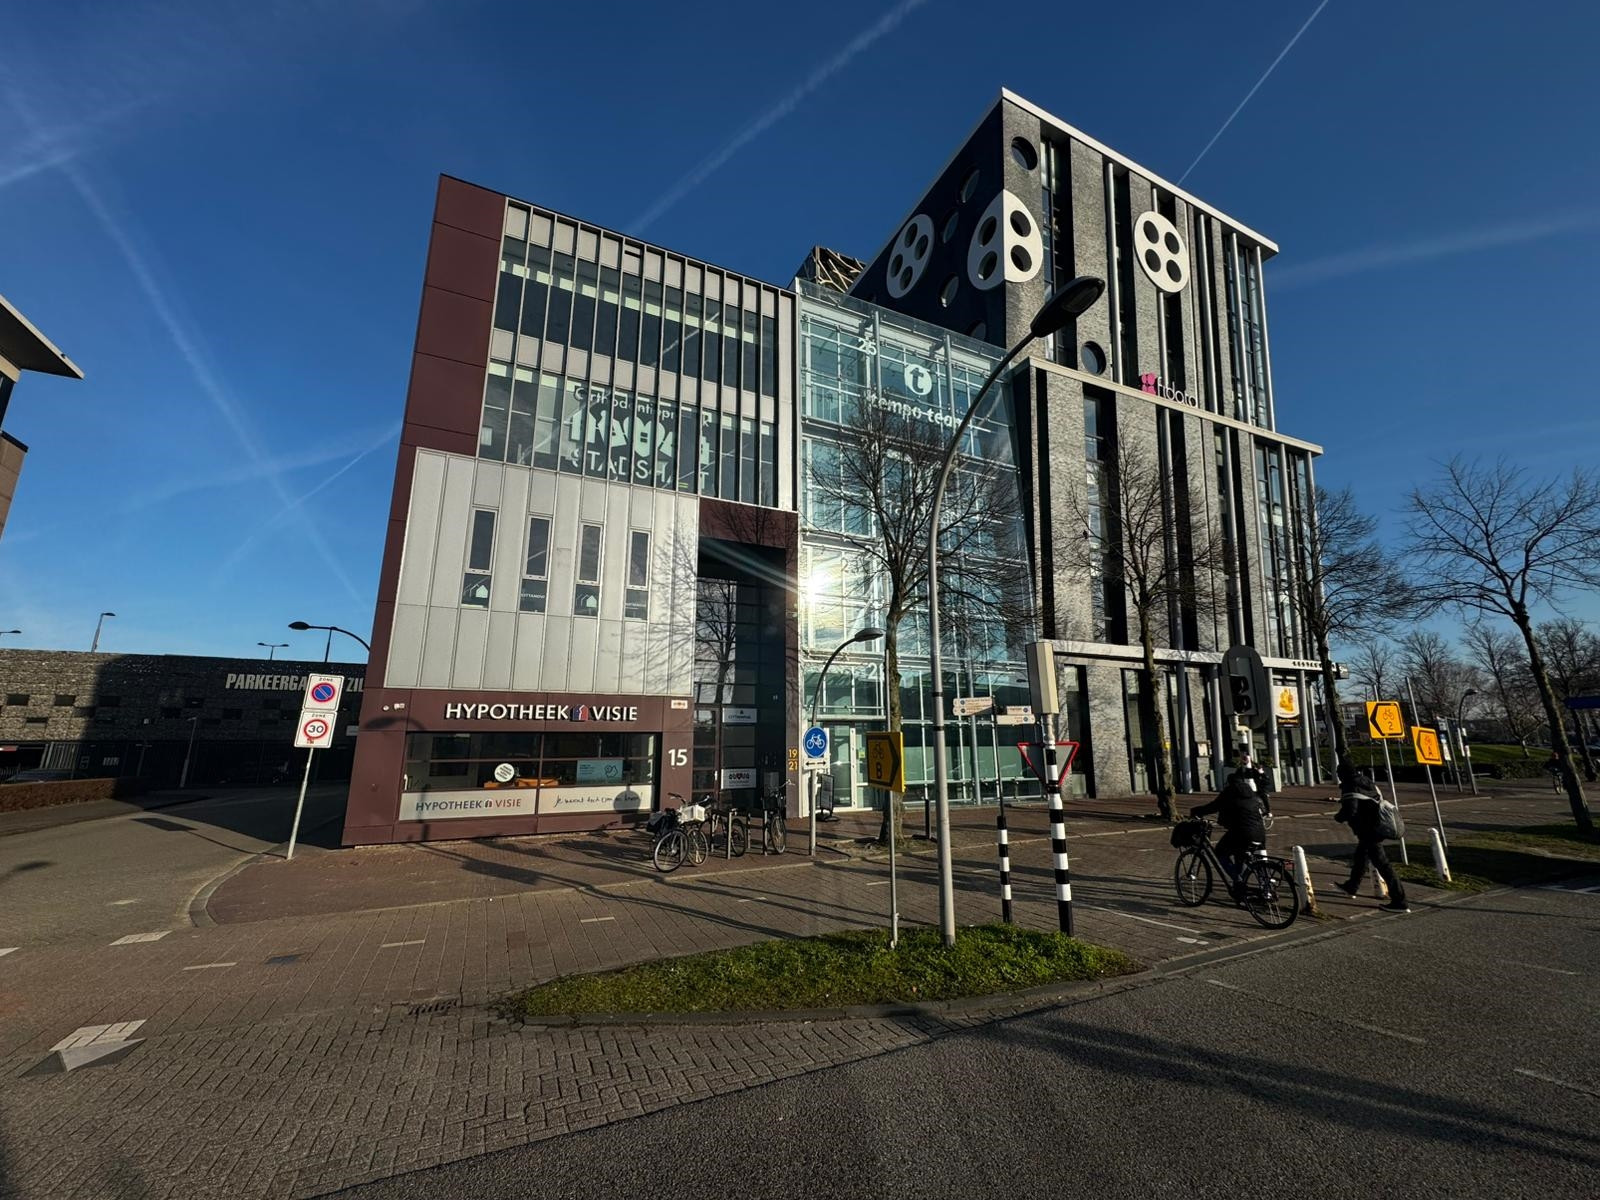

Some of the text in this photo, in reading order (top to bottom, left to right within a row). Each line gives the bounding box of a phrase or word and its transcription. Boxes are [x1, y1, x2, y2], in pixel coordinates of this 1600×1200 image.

[858, 338, 877, 356] 25
[225, 673, 364, 692] PARKEERGA ZIL
[445, 702, 638, 721] HYPOTHEEK VISIE
[308, 724, 325, 734] 30
[1388, 721, 1394, 731] 2
[668, 749, 688, 767] 15
[788, 748, 798, 758] 19
[788, 761, 798, 771] 21
[416, 799, 522, 811] HYPOTHEEK VISIE
